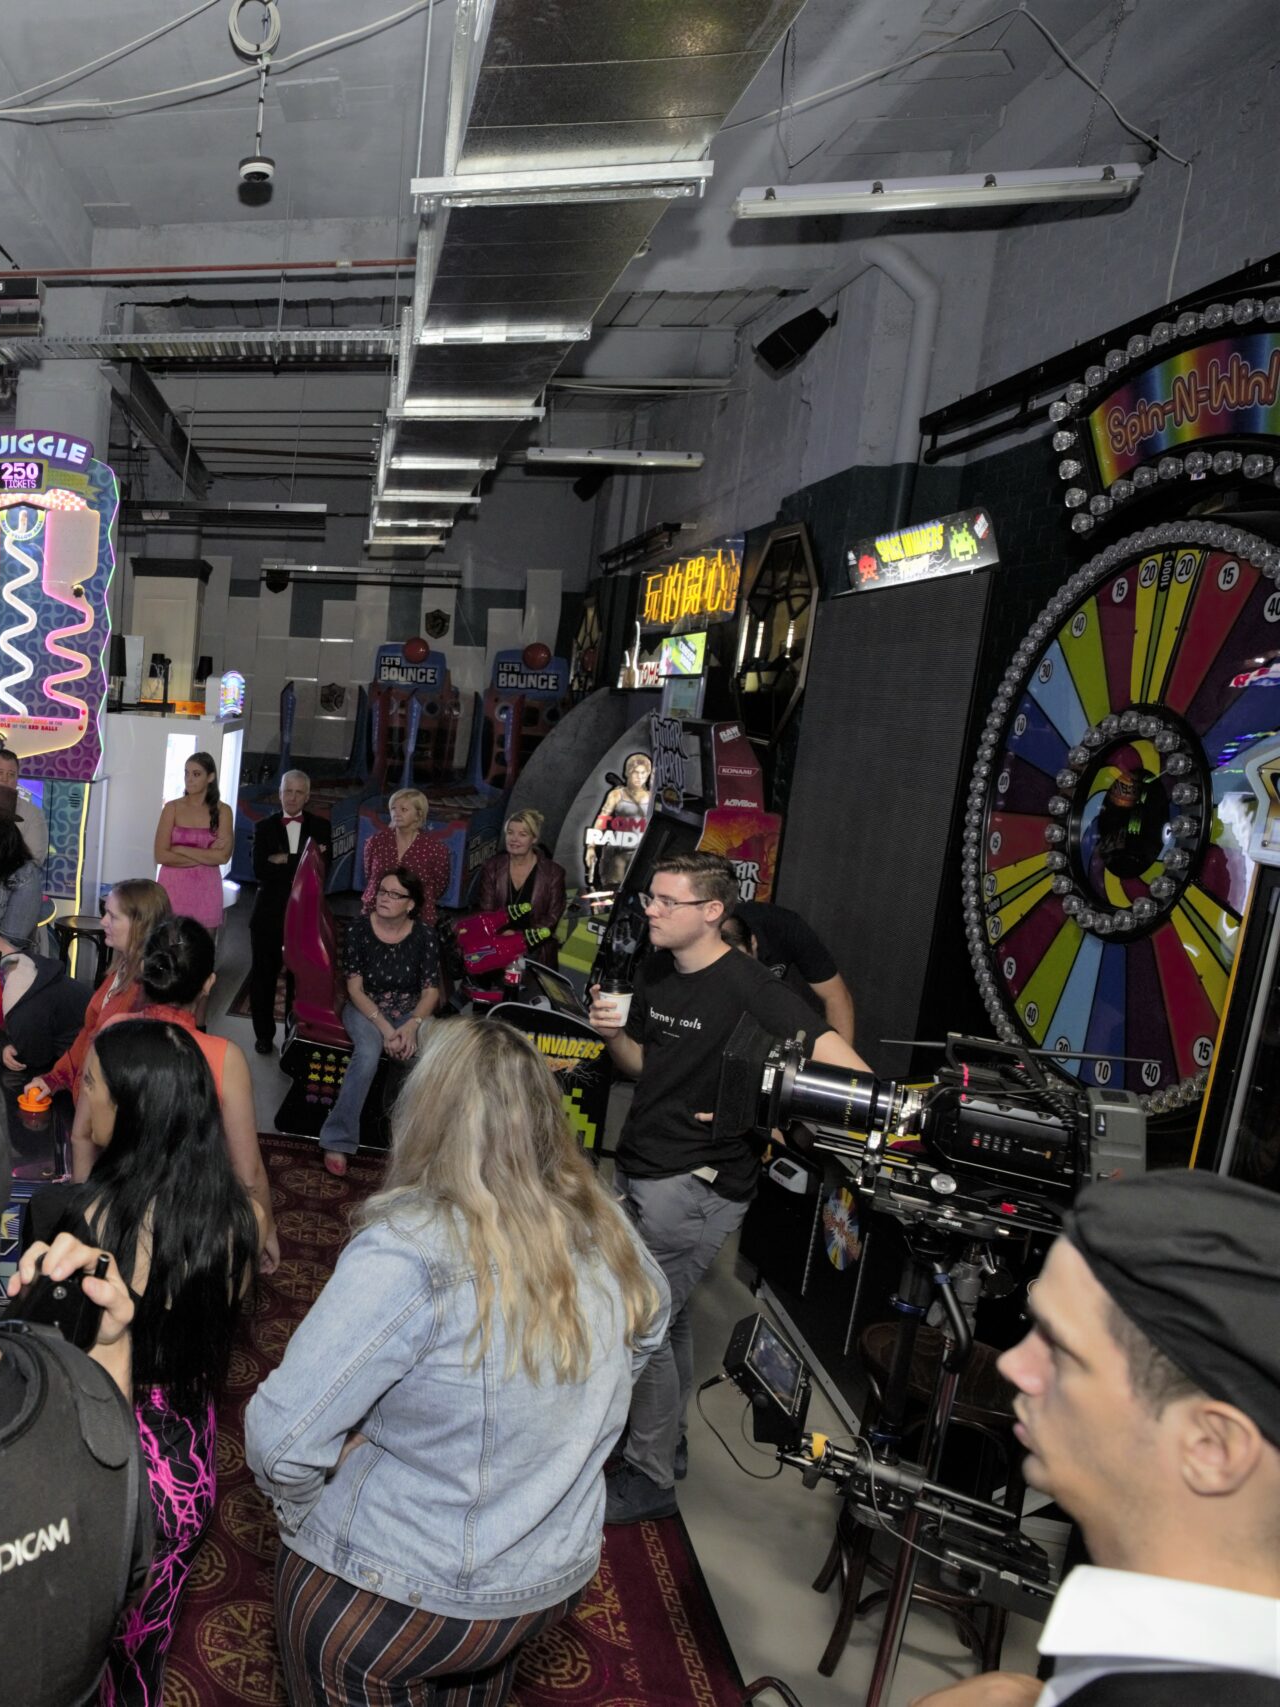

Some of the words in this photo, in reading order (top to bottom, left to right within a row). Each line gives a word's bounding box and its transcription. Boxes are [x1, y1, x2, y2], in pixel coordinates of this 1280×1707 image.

[1, 462, 39, 480] 250
[4, 479, 37, 489] TICKETS
[1142, 566, 1156, 583] 20
[1161, 560, 1173, 588] 1000
[1178, 557, 1193, 576] 20
[1222, 566, 1236, 585] 15
[1115, 581, 1125, 598] 15
[1073, 617, 1084, 633] 40
[380, 656, 401, 666] LET'S
[498, 663, 520, 672] LET'S
[380, 666, 437, 684] BOUNCE
[1040, 663, 1051, 678] 30
[498, 673, 559, 690] BOUNCE
[721, 768, 753, 776] KONAMI
[597, 815, 646, 833] TOM
[585, 828, 642, 847] RAID
[991, 920, 1001, 935] 20
[1006, 961, 1014, 975] 15
[650, 1007, 675, 1028] barney
[1026, 1007, 1037, 1020] 40
[537, 1032, 605, 1060] INVADERS
[1197, 1041, 1211, 1062] 15
[1097, 1064, 1109, 1080] 10
[1145, 1063, 1158, 1082] 40
